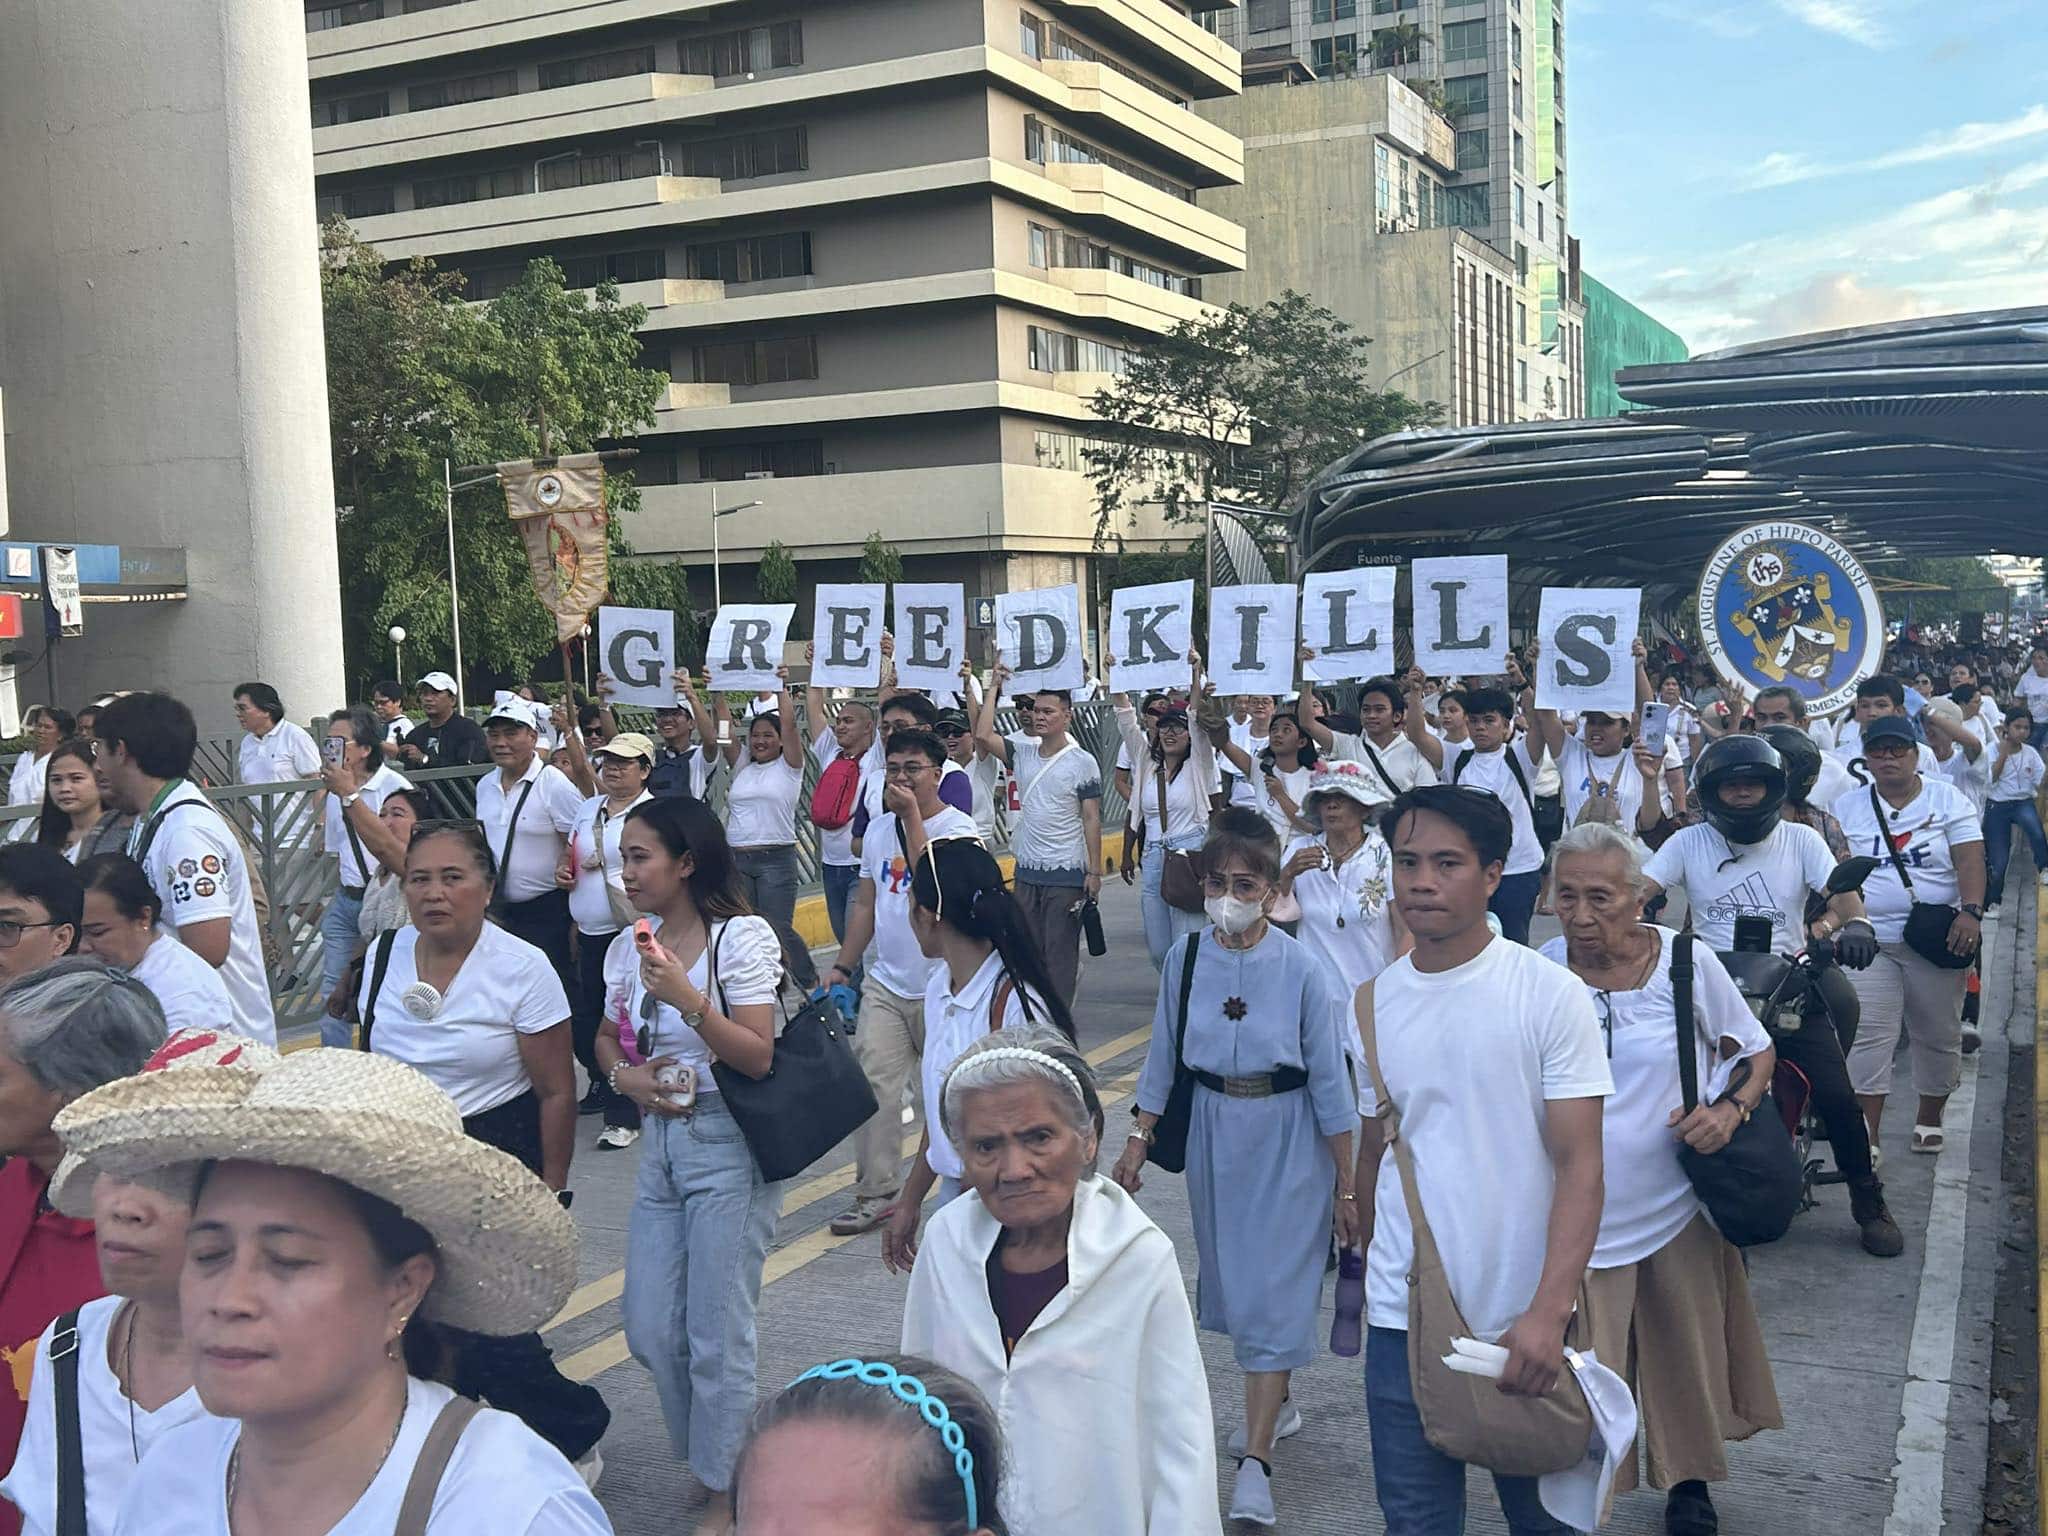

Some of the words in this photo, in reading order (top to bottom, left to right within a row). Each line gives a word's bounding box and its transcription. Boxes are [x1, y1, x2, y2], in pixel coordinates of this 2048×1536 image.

[1358, 554, 1402, 565] Fuente
[1700, 542, 1738, 631] AUGUSTINE
[1741, 528, 1765, 546] OF
[1770, 525, 1823, 546] HIPPO
[1824, 542, 1868, 589] PARISH
